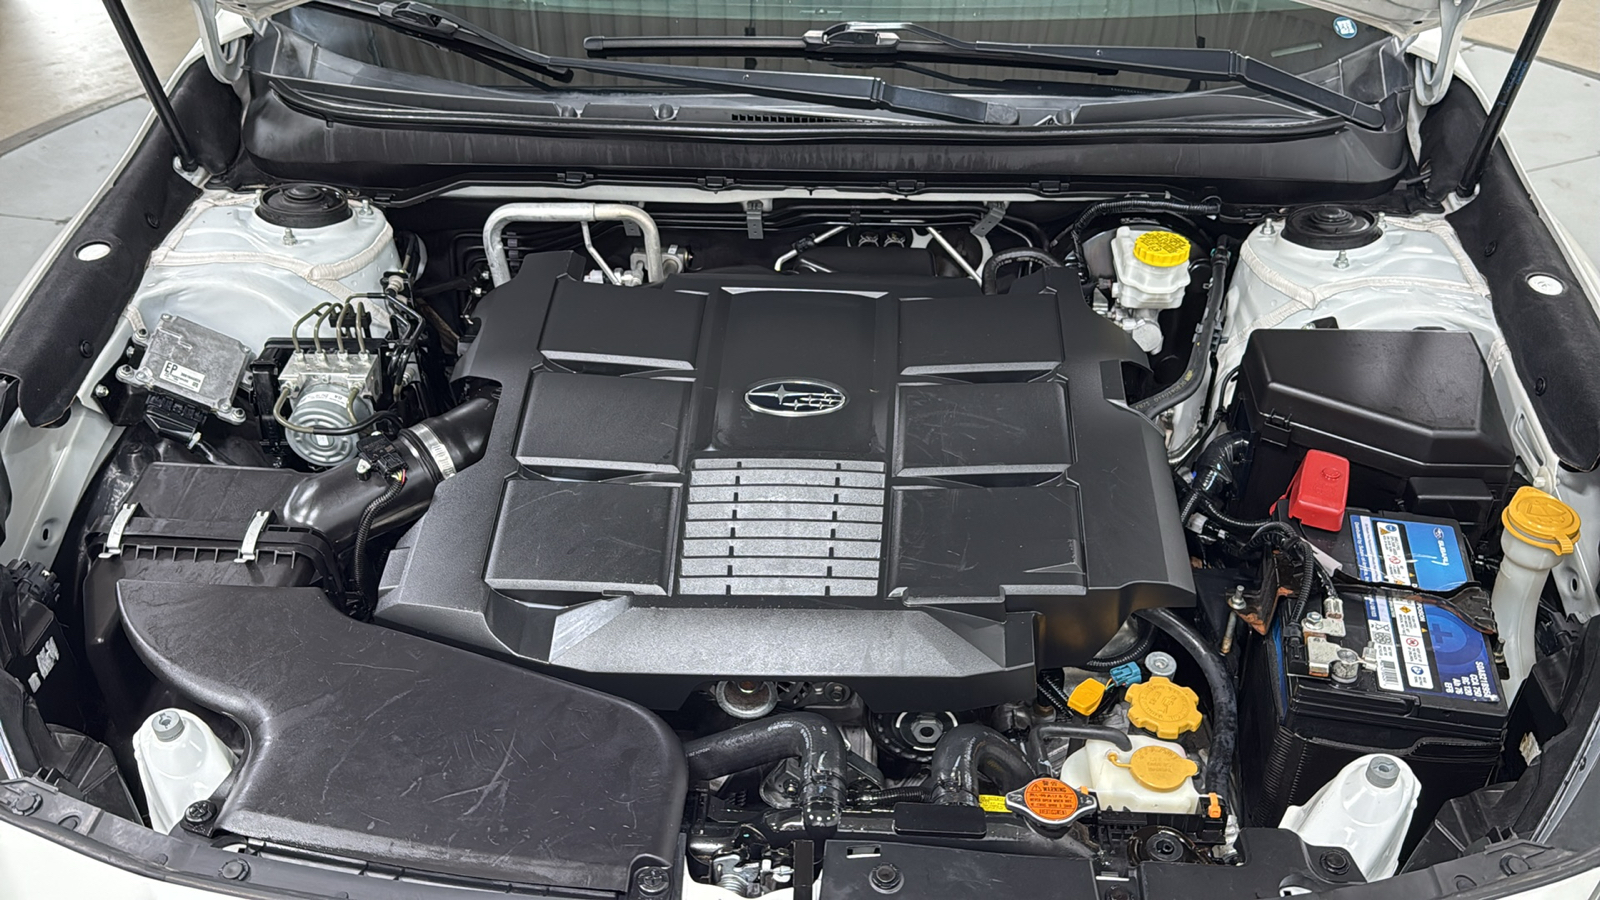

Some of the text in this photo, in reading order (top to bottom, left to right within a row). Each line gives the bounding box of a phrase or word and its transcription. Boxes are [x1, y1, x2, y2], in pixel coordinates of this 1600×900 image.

[164, 362, 179, 375] EP
[1437, 540, 1449, 566] SUBARU
[1469, 674, 1480, 686] CCA
